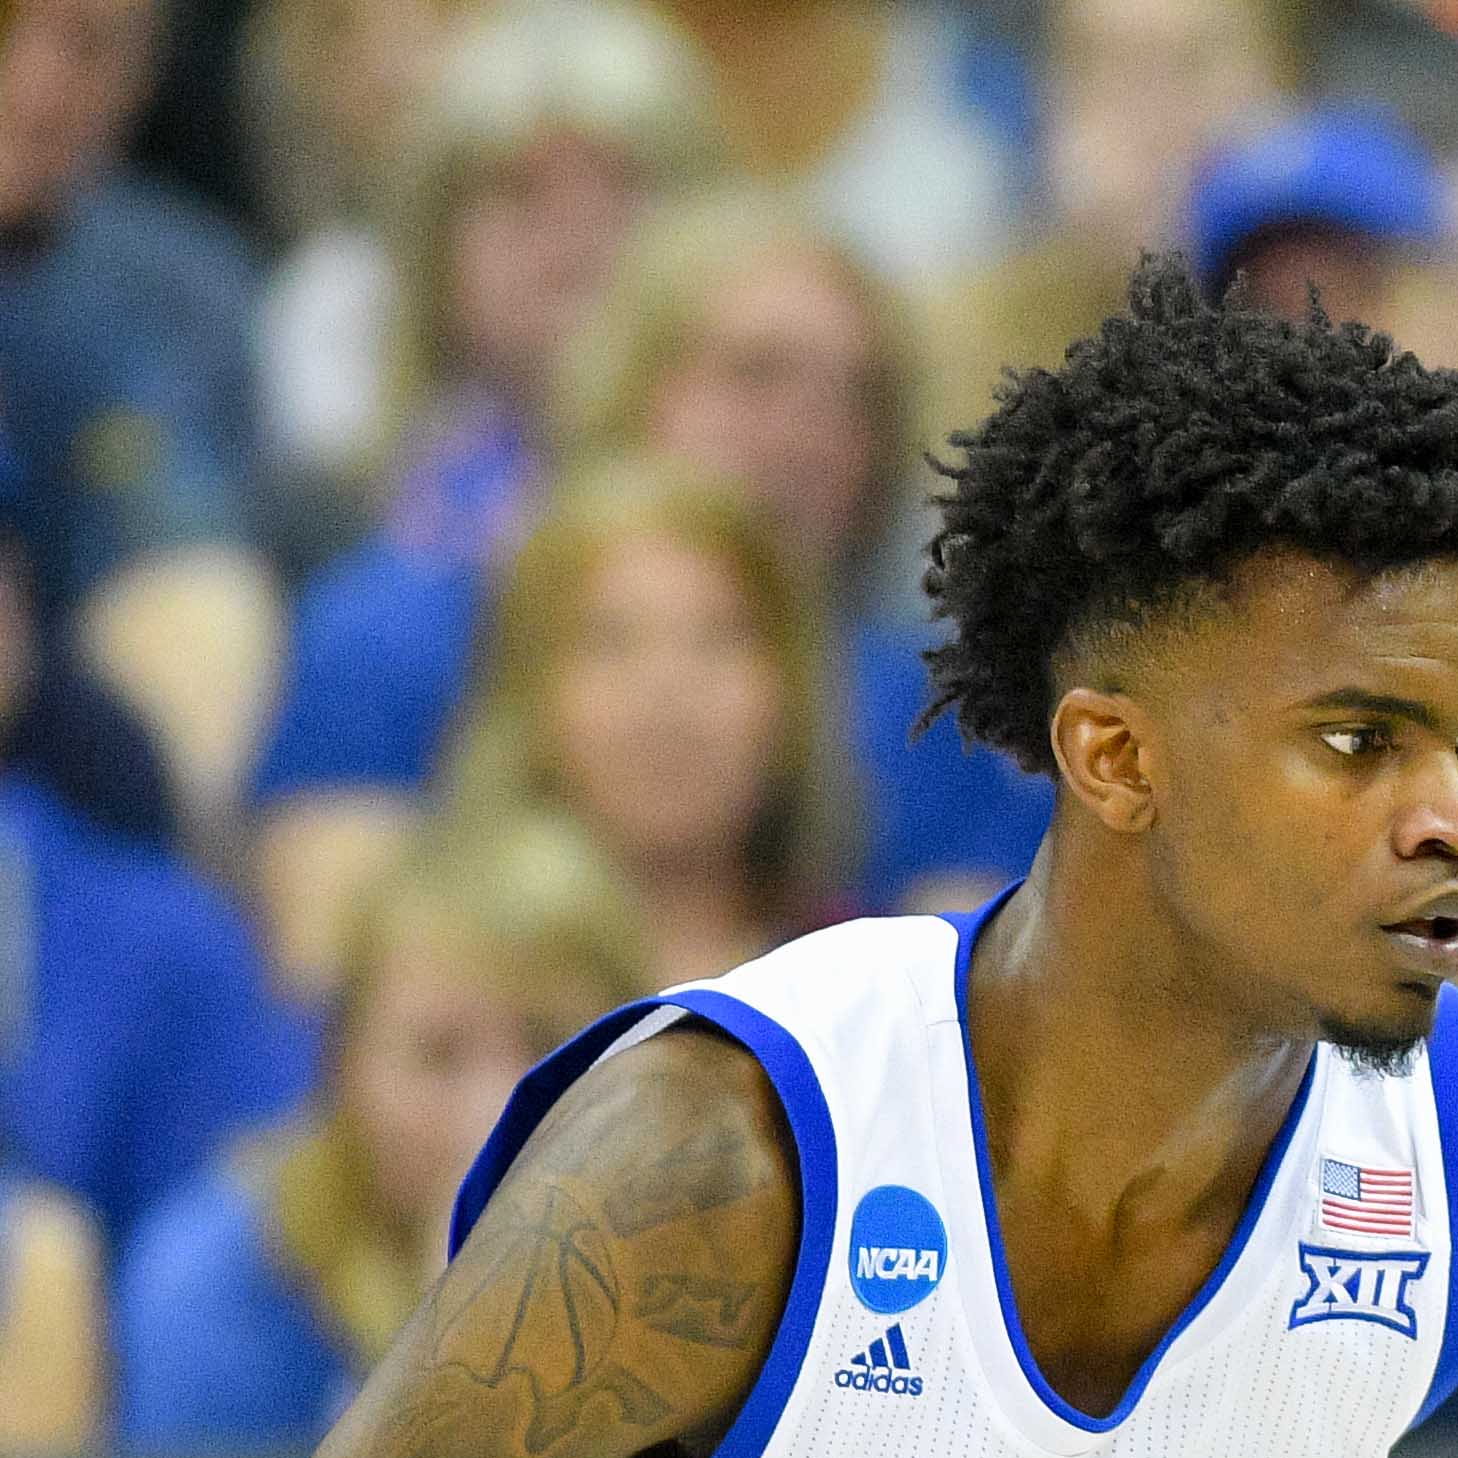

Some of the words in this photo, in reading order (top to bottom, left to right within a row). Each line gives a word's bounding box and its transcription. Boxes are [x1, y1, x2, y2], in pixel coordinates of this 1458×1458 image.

[856, 1246, 939, 1281] NCAA
[1289, 1240, 1431, 1340] XII
[834, 1363, 924, 1396] adidas
